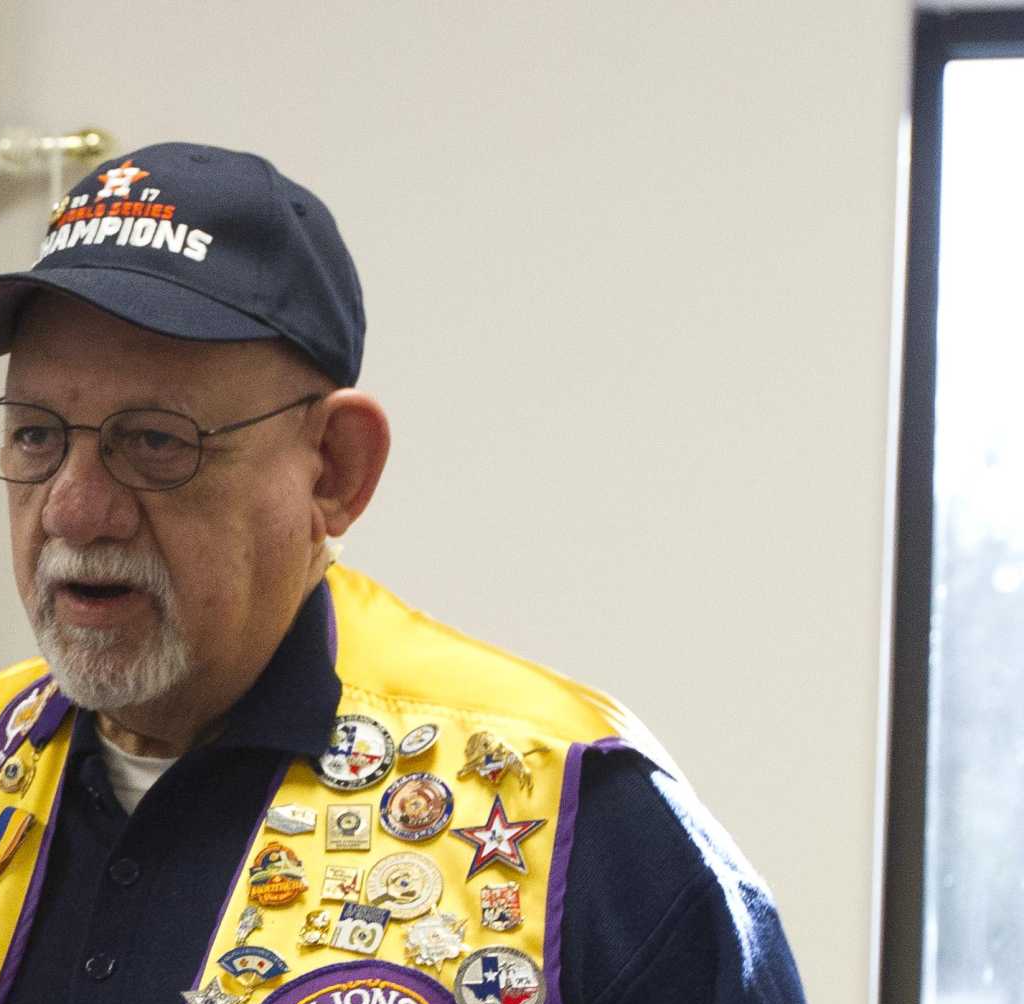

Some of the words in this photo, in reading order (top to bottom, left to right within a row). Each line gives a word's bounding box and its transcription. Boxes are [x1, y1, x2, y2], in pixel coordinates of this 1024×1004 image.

[140, 187, 161, 202] 17
[108, 203, 176, 220] SERIES
[32, 216, 214, 265] HAMPIONS
